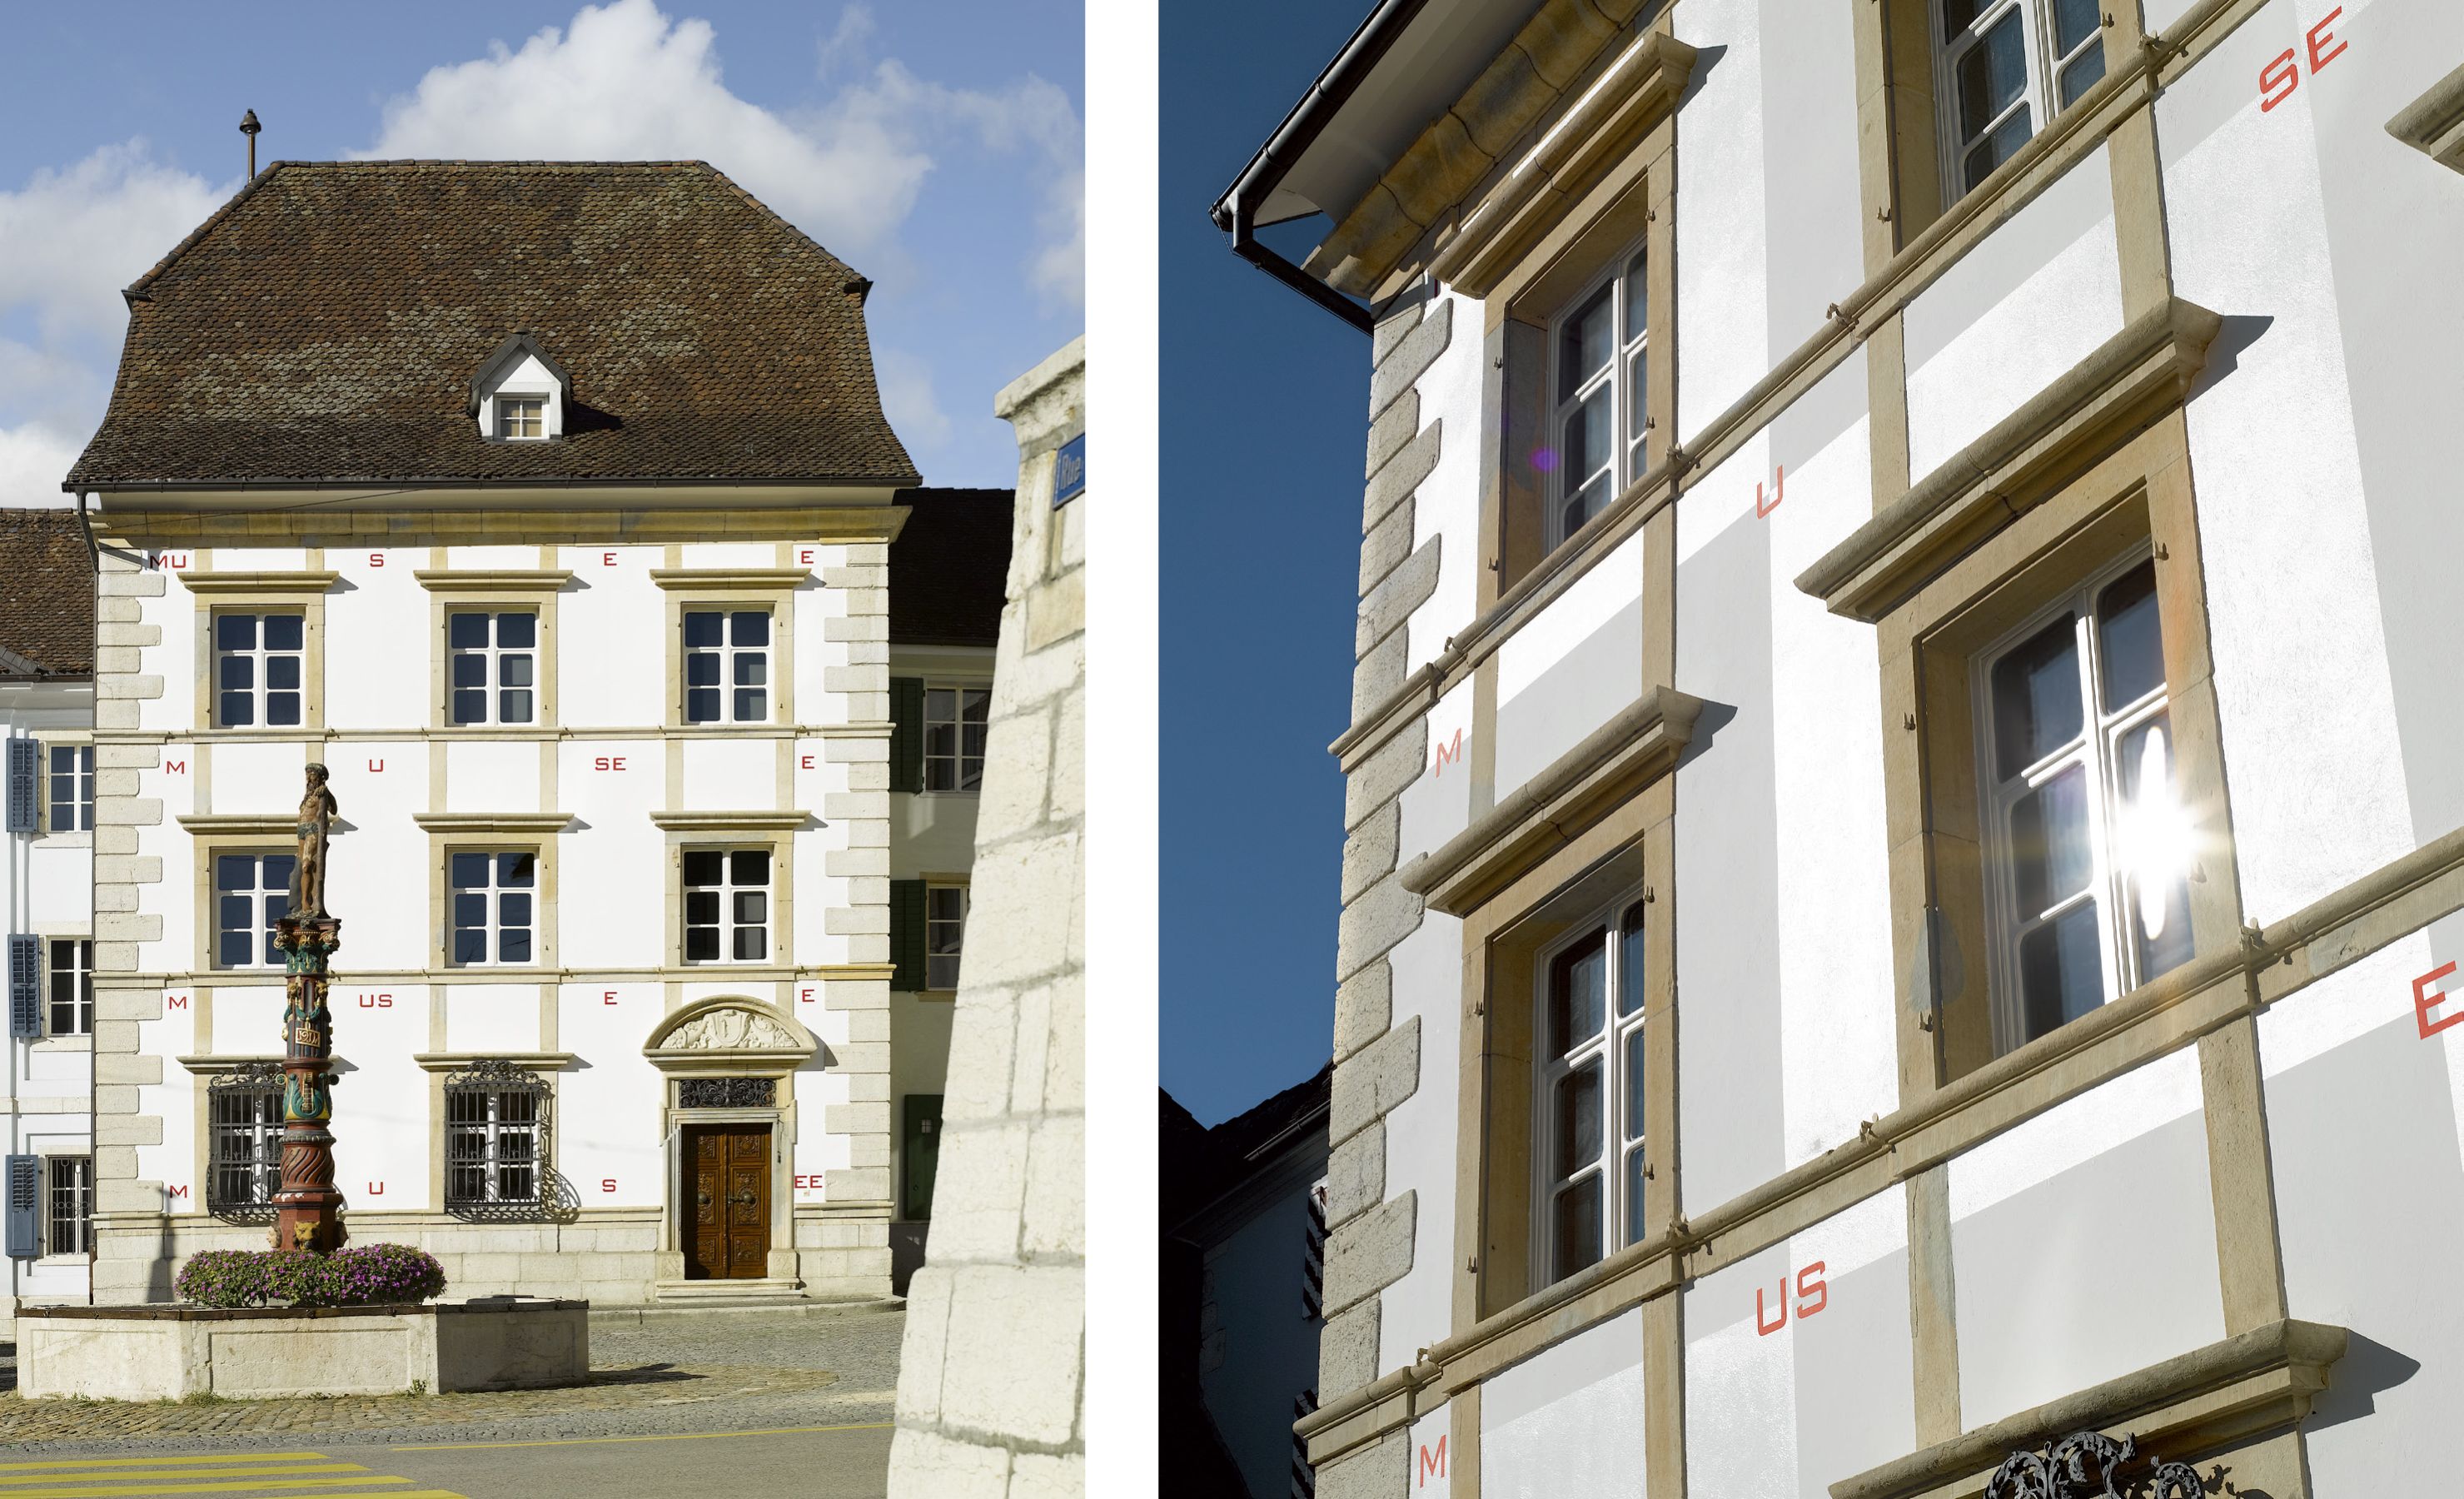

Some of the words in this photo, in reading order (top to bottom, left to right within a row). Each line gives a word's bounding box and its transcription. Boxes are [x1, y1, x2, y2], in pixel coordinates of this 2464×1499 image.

[2258, 5, 2349, 113] SE
[1060, 453, 1082, 491] Rue
[1756, 464, 1784, 520] U
[150, 555, 187, 569] MU
[369, 553, 385, 568] S
[603, 552, 617, 567] E
[800, 550, 814, 565] E
[166, 759, 186, 774] M
[368, 759, 384, 773] U
[594, 756, 627, 772] SE
[801, 755, 814, 770] E
[1436, 728, 1461, 778] M
[168, 995, 187, 1010] M
[359, 994, 393, 1008] US
[604, 991, 617, 1006] E
[801, 989, 814, 1003] E
[2412, 960, 2464, 1040] E
[169, 1184, 188, 1199] M
[368, 1181, 384, 1196] U
[601, 1178, 617, 1193] S
[794, 1174, 823, 1189] EE
[1756, 1260, 1828, 1337] US
[1419, 1434, 1447, 1489] M
